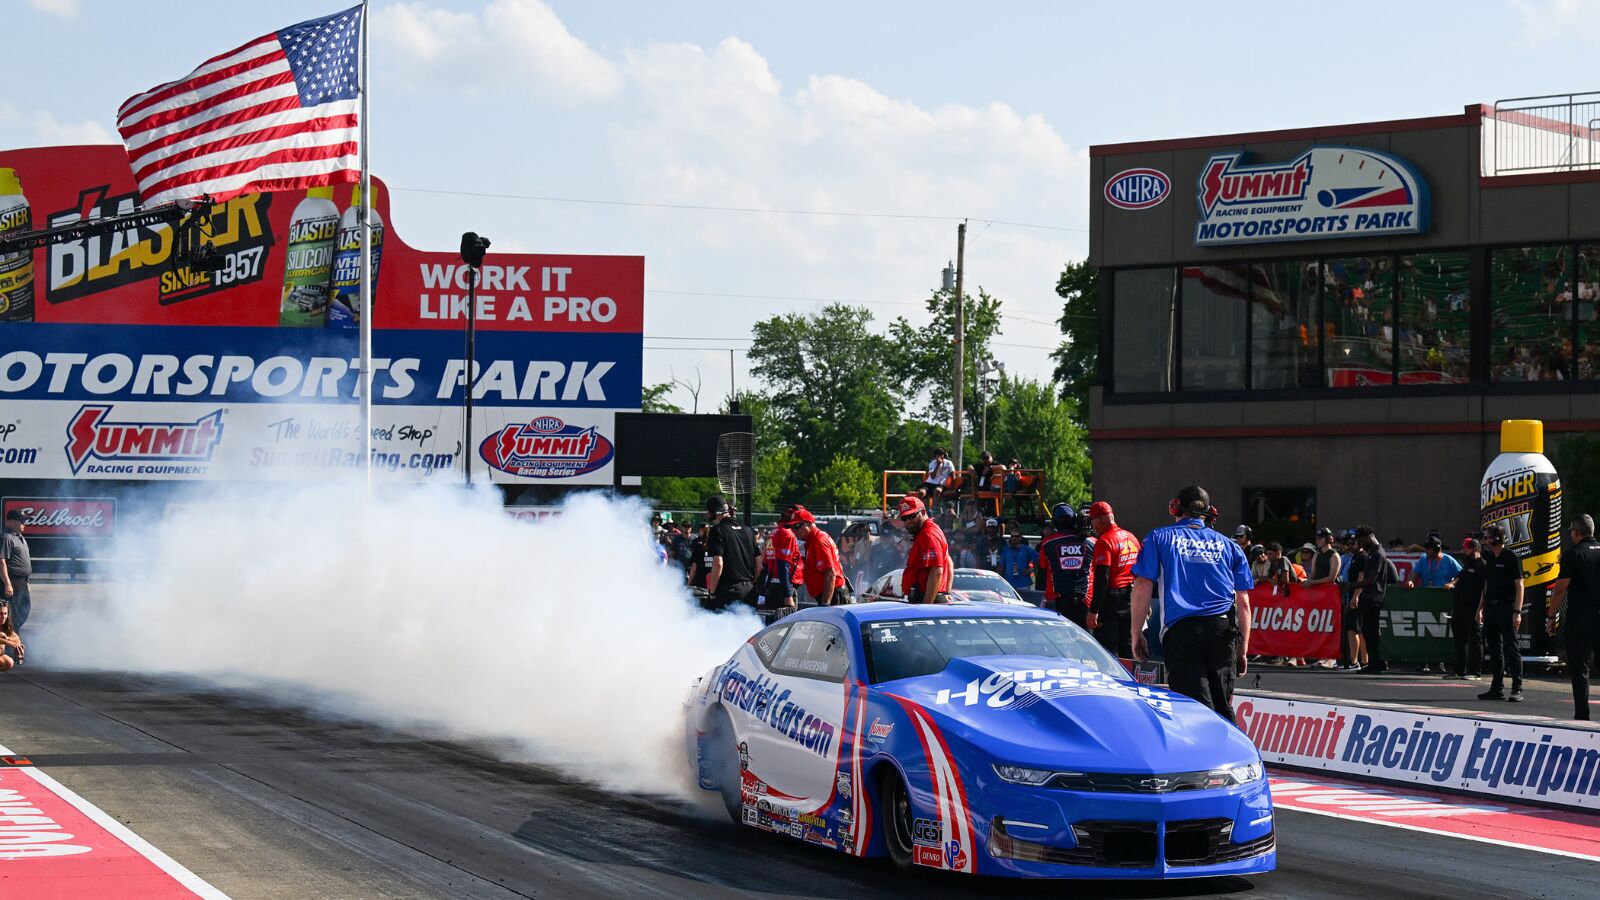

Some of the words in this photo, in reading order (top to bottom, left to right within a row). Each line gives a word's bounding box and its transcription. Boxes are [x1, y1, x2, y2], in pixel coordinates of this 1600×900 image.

[1114, 177, 1161, 203] NHRA
[0, 207, 28, 231] STER
[1215, 208, 1249, 217] RACING
[1250, 204, 1303, 215] EQUIPMENT
[1199, 215, 1348, 239] MOTORSPORTS
[1354, 211, 1413, 230] PARK
[215, 245, 264, 286] 1957
[288, 248, 333, 270] SILICON
[420, 263, 531, 291] WORK
[541, 266, 572, 292] IT
[419, 293, 496, 320] LIKE
[506, 296, 532, 321] A
[543, 296, 617, 323] PRO
[436, 358, 616, 401] PARK
[268, 417, 300, 443] The
[355, 423, 395, 442] Seed
[398, 424, 433, 447] Shop
[534, 417, 561, 431] NHRA
[87, 465, 134, 474] RACING
[137, 465, 208, 475] EQUIPMENT
[250, 446, 453, 472] SummitRaing.com
[510, 460, 541, 468] RACING
[541, 461, 588, 469] EQUIPMENT
[517, 467, 547, 476] Racing
[547, 468, 576, 476] Series
[21, 507, 104, 528] Edelbrock
[1060, 545, 1083, 556] FOX
[1251, 606, 1305, 632] LUCAS
[1307, 607, 1334, 633] OIL
[880, 628, 896, 638] 1
[1235, 701, 1346, 760] Summit
[1341, 714, 1464, 782] Racing
[922, 851, 940, 862] DENSO
